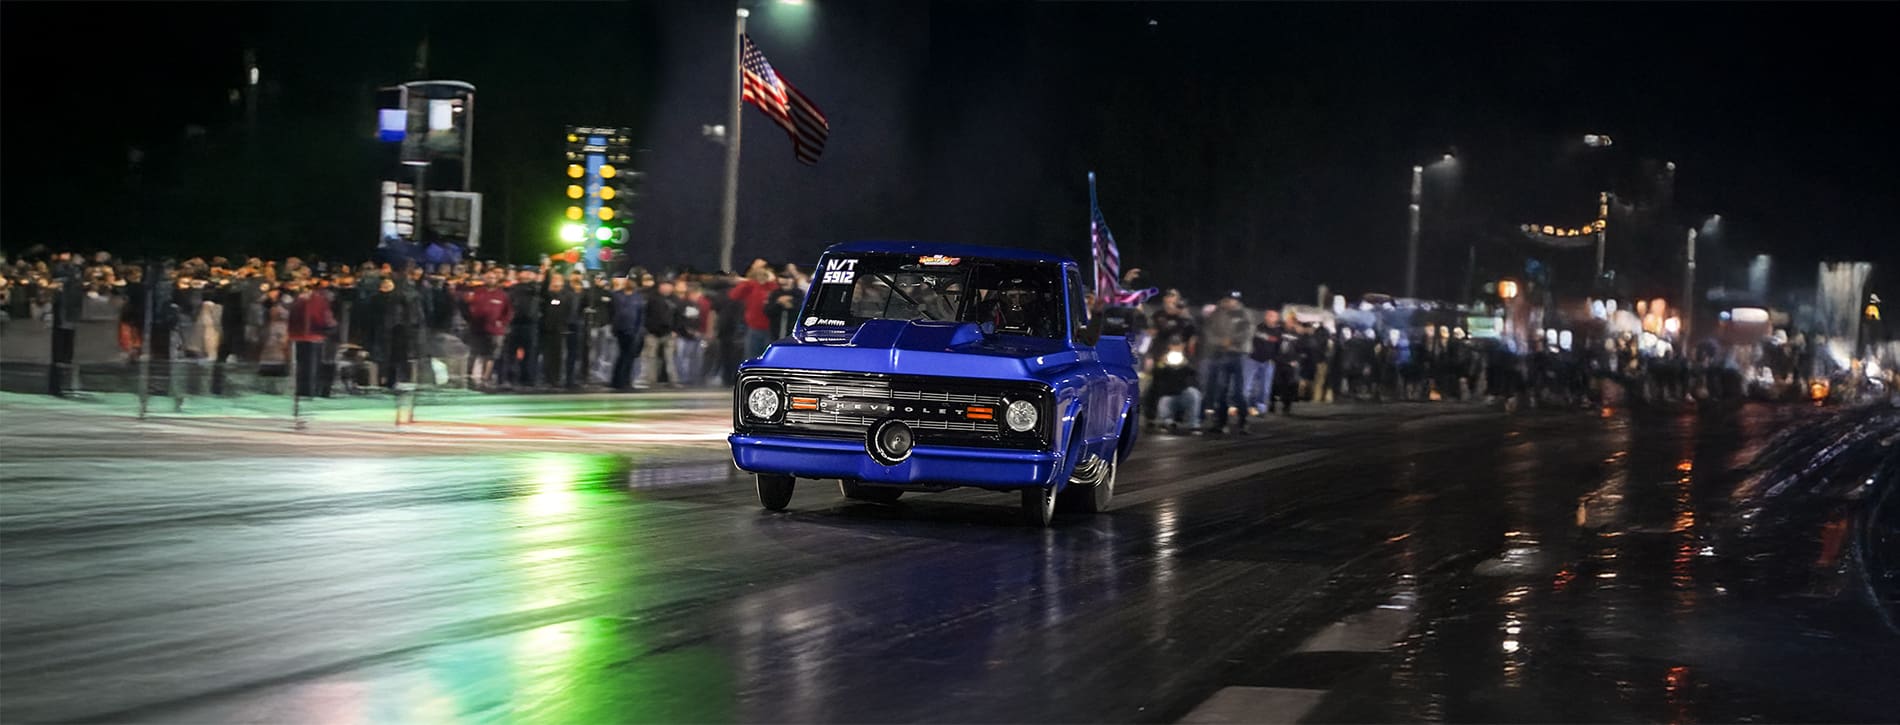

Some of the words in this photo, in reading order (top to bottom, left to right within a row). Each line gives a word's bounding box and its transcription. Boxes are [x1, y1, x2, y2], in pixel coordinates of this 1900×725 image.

[826, 259, 858, 271] N/T
[822, 271, 855, 284] 5912
[820, 402, 964, 415] CHEVROLET
